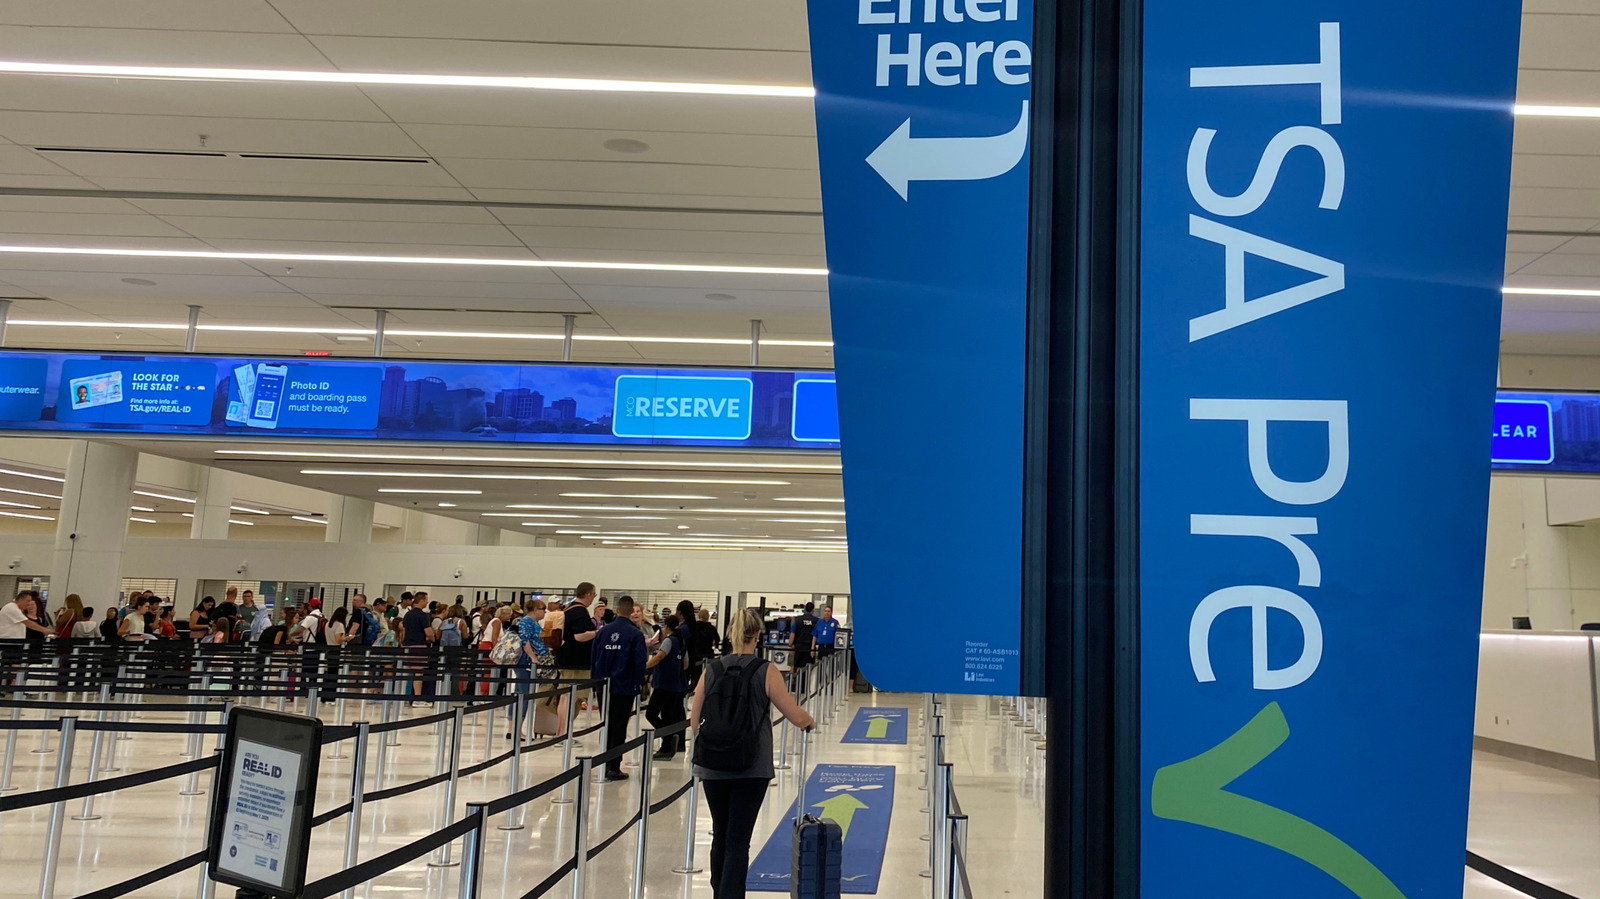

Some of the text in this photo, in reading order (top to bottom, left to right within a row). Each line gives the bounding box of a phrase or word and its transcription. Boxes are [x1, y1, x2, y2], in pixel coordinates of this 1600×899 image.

[876, 33, 1032, 87] Here
[1186, 21, 1350, 691] TSA Pre
[133, 373, 180, 383] LOOK FOR
[0, 385, 40, 395] uterwear.
[132, 382, 173, 392] THE STAR
[290, 381, 330, 390] Photo ID
[289, 392, 367, 404] and boarding pass
[129, 404, 192, 413] TSA.gov/REAL-ID
[288, 404, 350, 414] must be ready.
[625, 396, 635, 417] MCO
[635, 396, 740, 418] RESERVE
[242, 758, 282, 779] REAL ID
